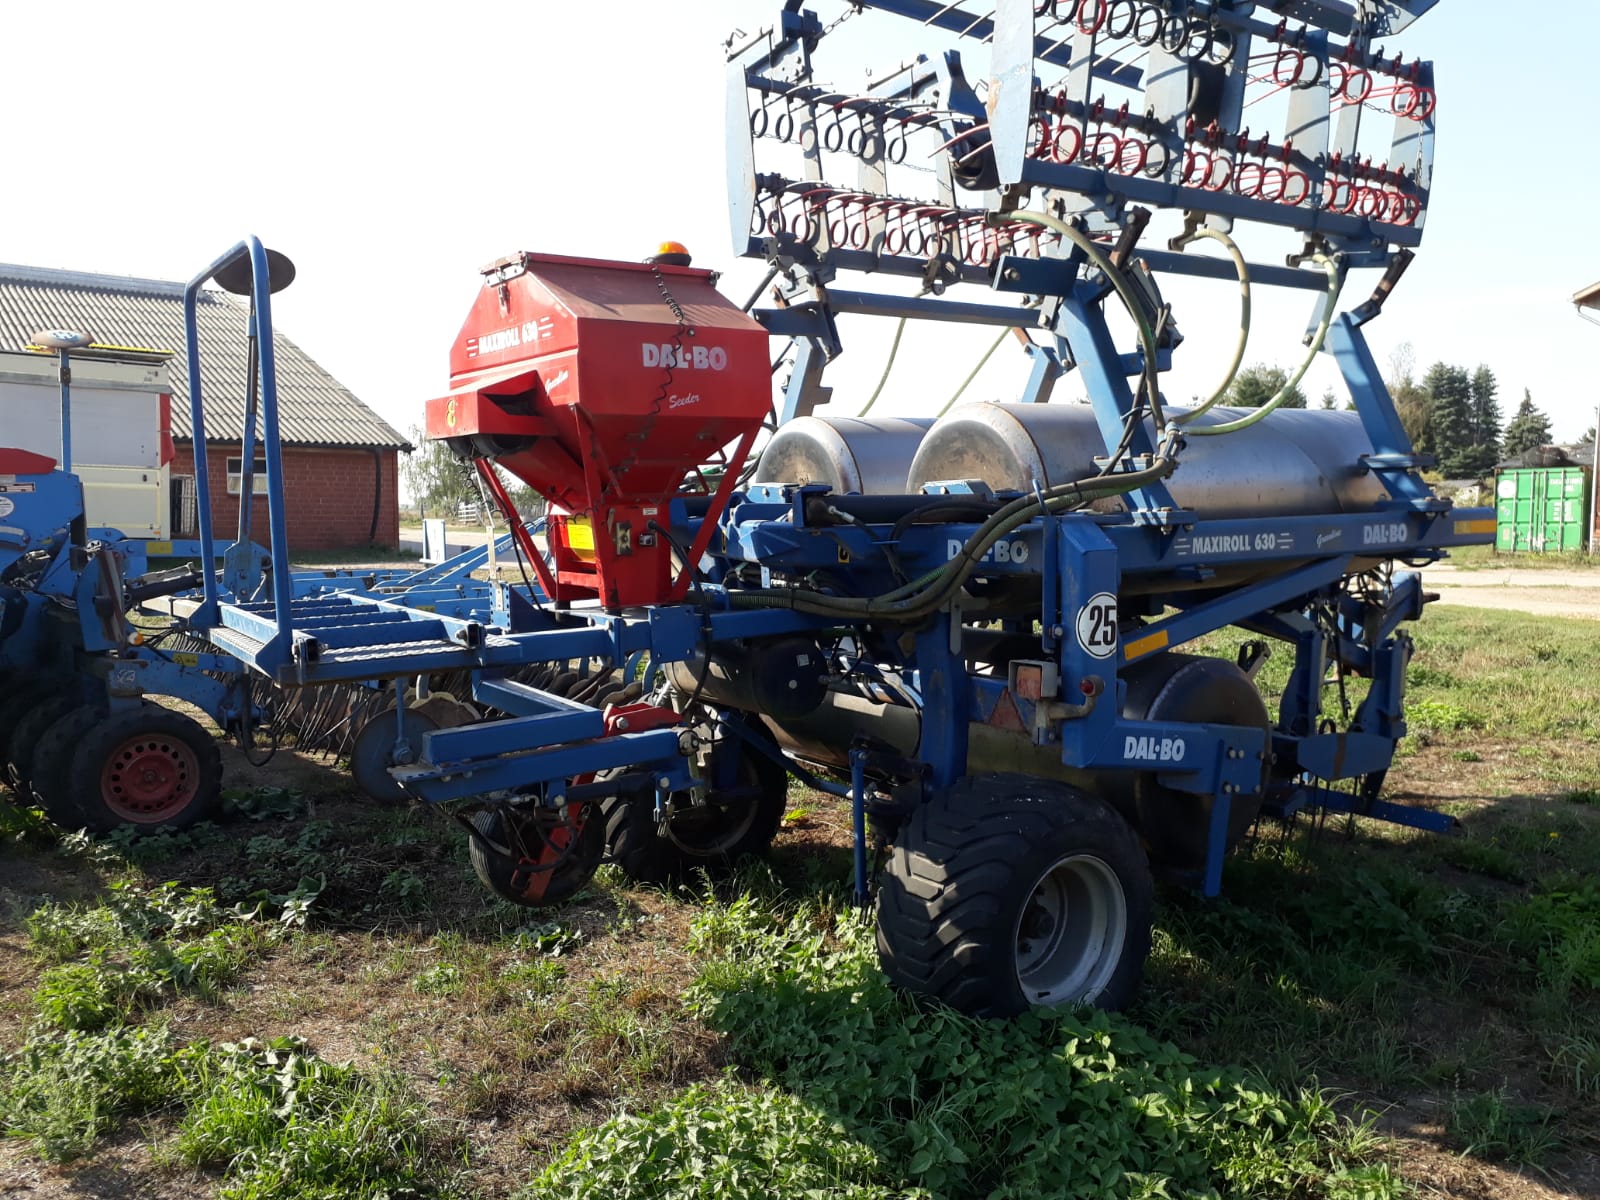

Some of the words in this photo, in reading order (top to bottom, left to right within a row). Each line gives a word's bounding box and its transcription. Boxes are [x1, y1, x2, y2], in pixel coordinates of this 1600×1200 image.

[668, 393, 700, 409] Seeder
[1192, 534, 1251, 554] MAXIROLL
[1254, 533, 1276, 550] 630
[1087, 604, 1116, 646] 25
